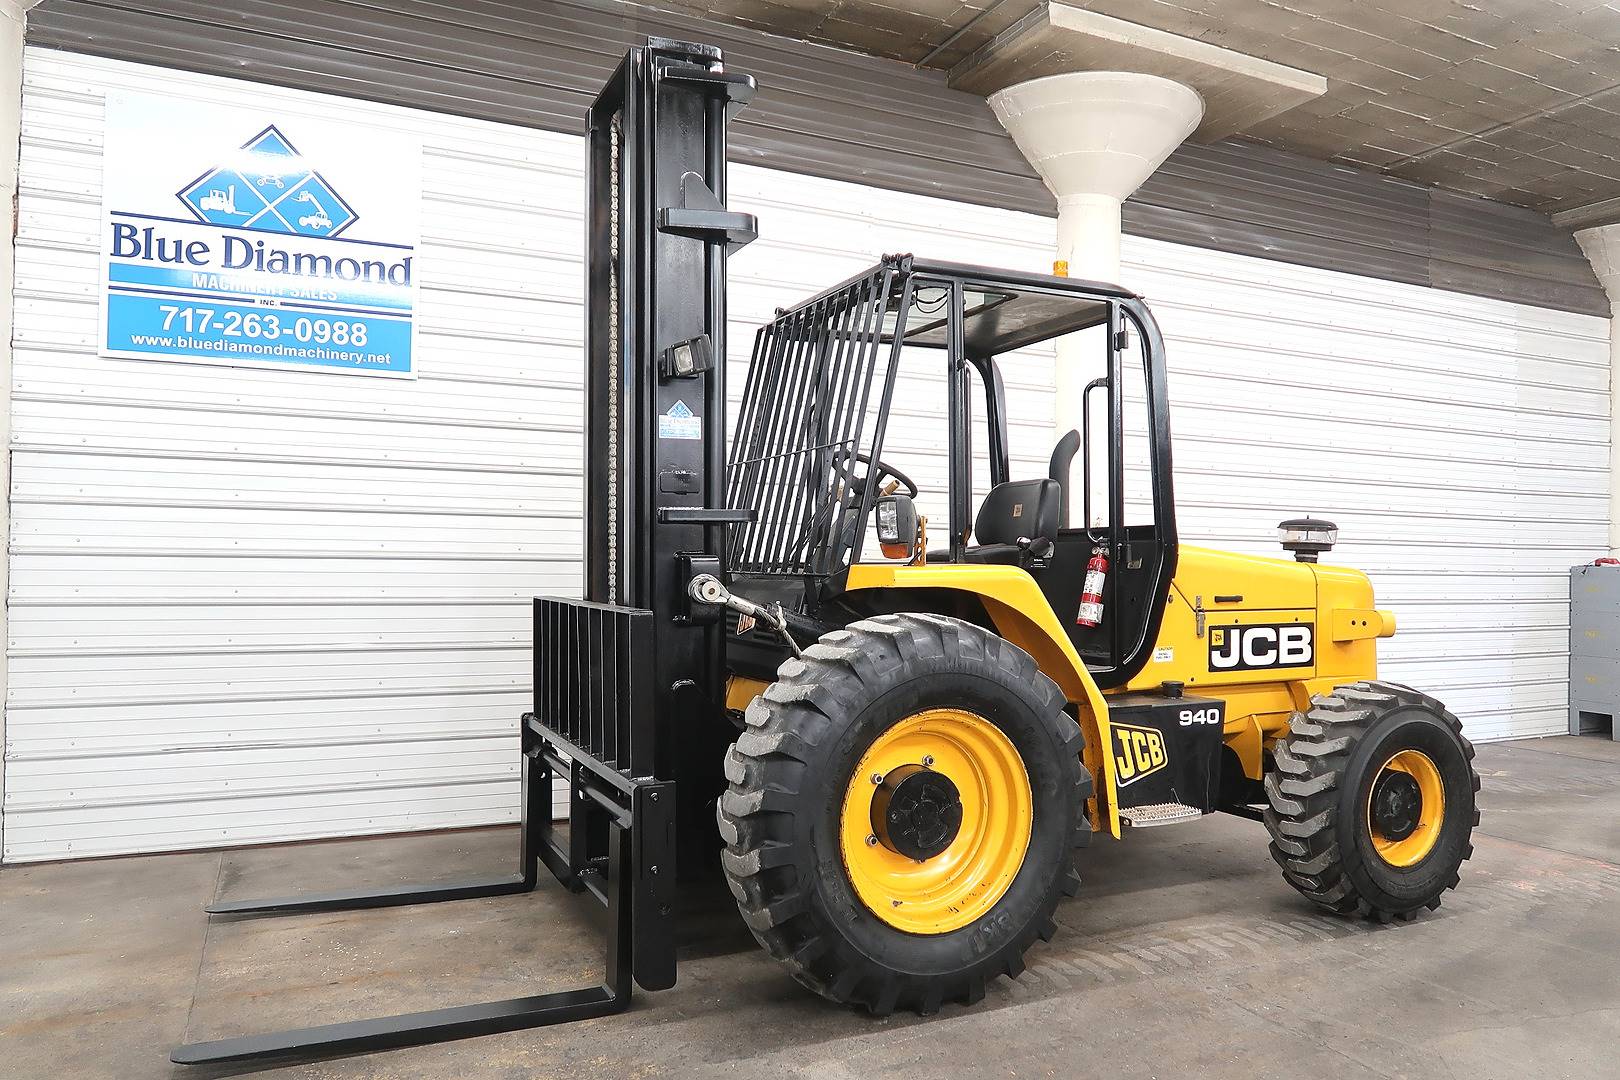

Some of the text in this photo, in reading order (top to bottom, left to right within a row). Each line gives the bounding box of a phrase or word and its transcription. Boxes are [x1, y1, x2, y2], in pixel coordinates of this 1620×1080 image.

[110, 222, 413, 287] Blue Diamond
[159, 305, 368, 347] 717-263-0988
[131, 333, 391, 364] www.bluediamondmachinery.net
[1210, 626, 1313, 668] JCB
[1179, 708, 1220, 726] 940
[1116, 729, 1164, 780] JCB
